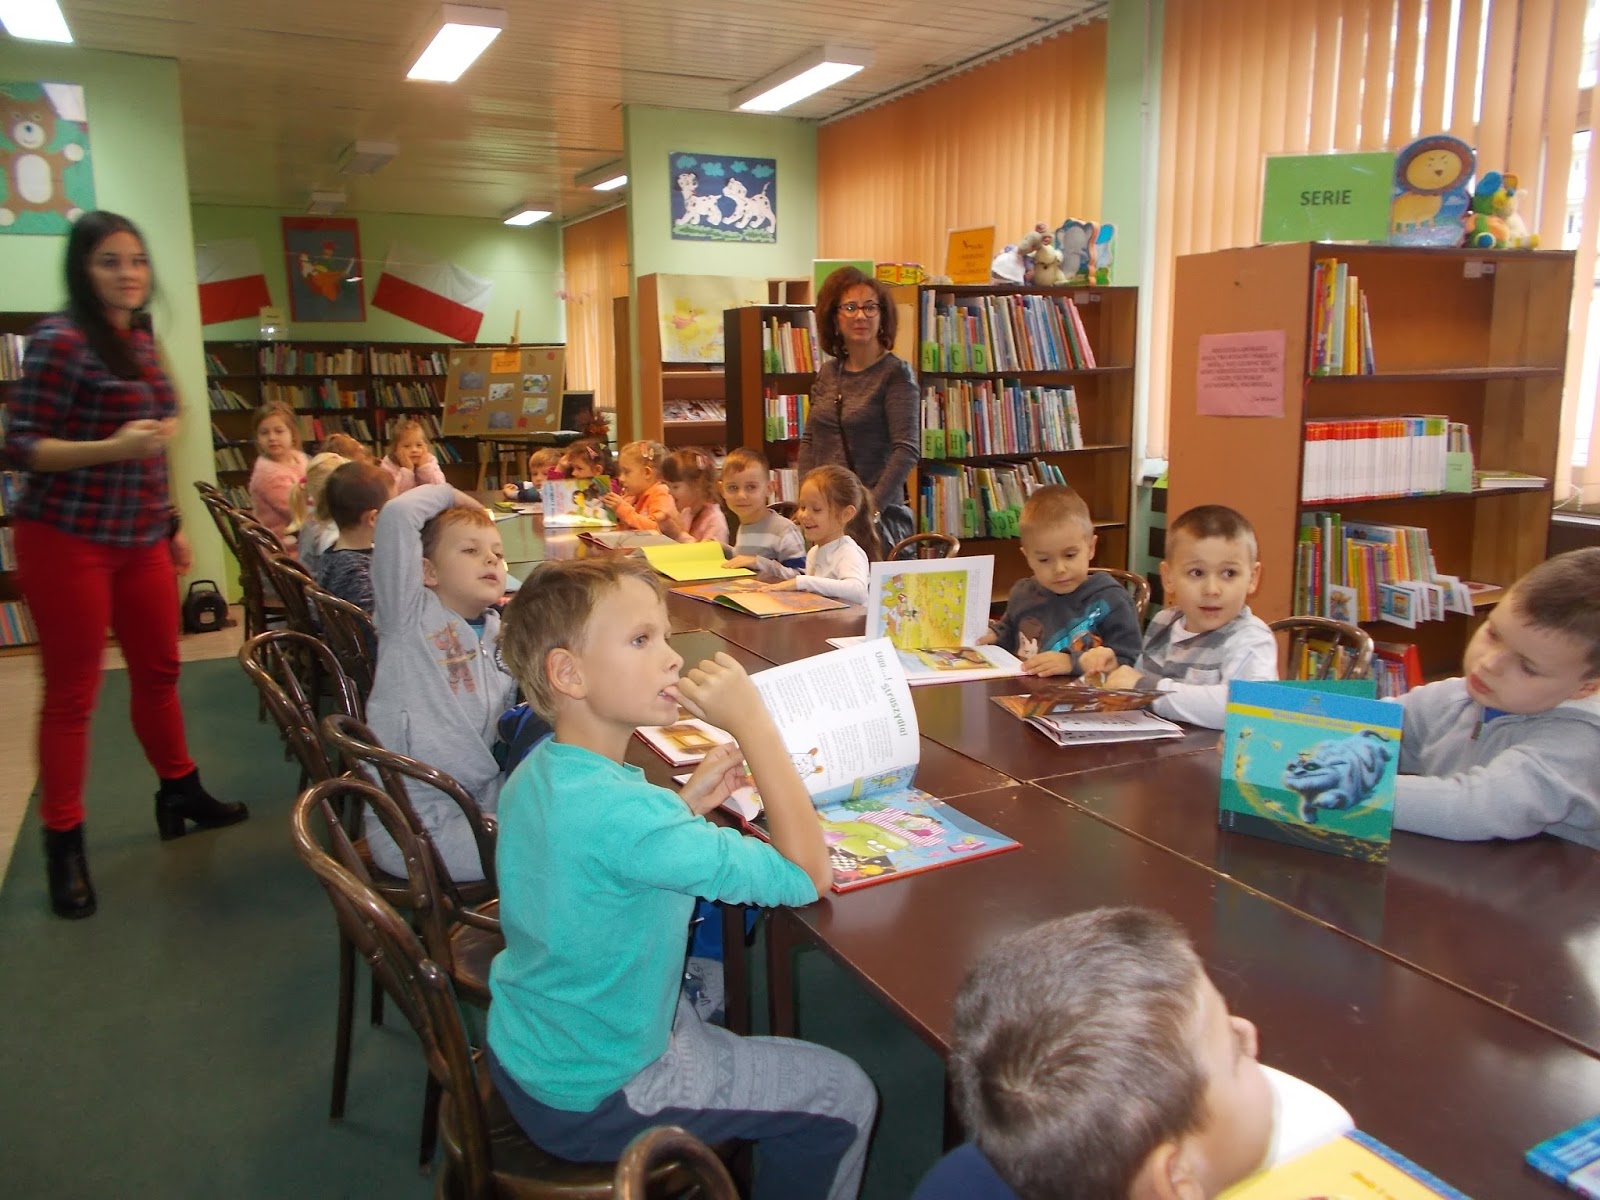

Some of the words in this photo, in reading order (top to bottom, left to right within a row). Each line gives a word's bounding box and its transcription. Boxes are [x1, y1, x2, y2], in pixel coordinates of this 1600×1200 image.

[1300, 189, 1352, 206] SERIE
[952, 350, 960, 365] C
[974, 350, 984, 364] D
[935, 436, 943, 452] G
